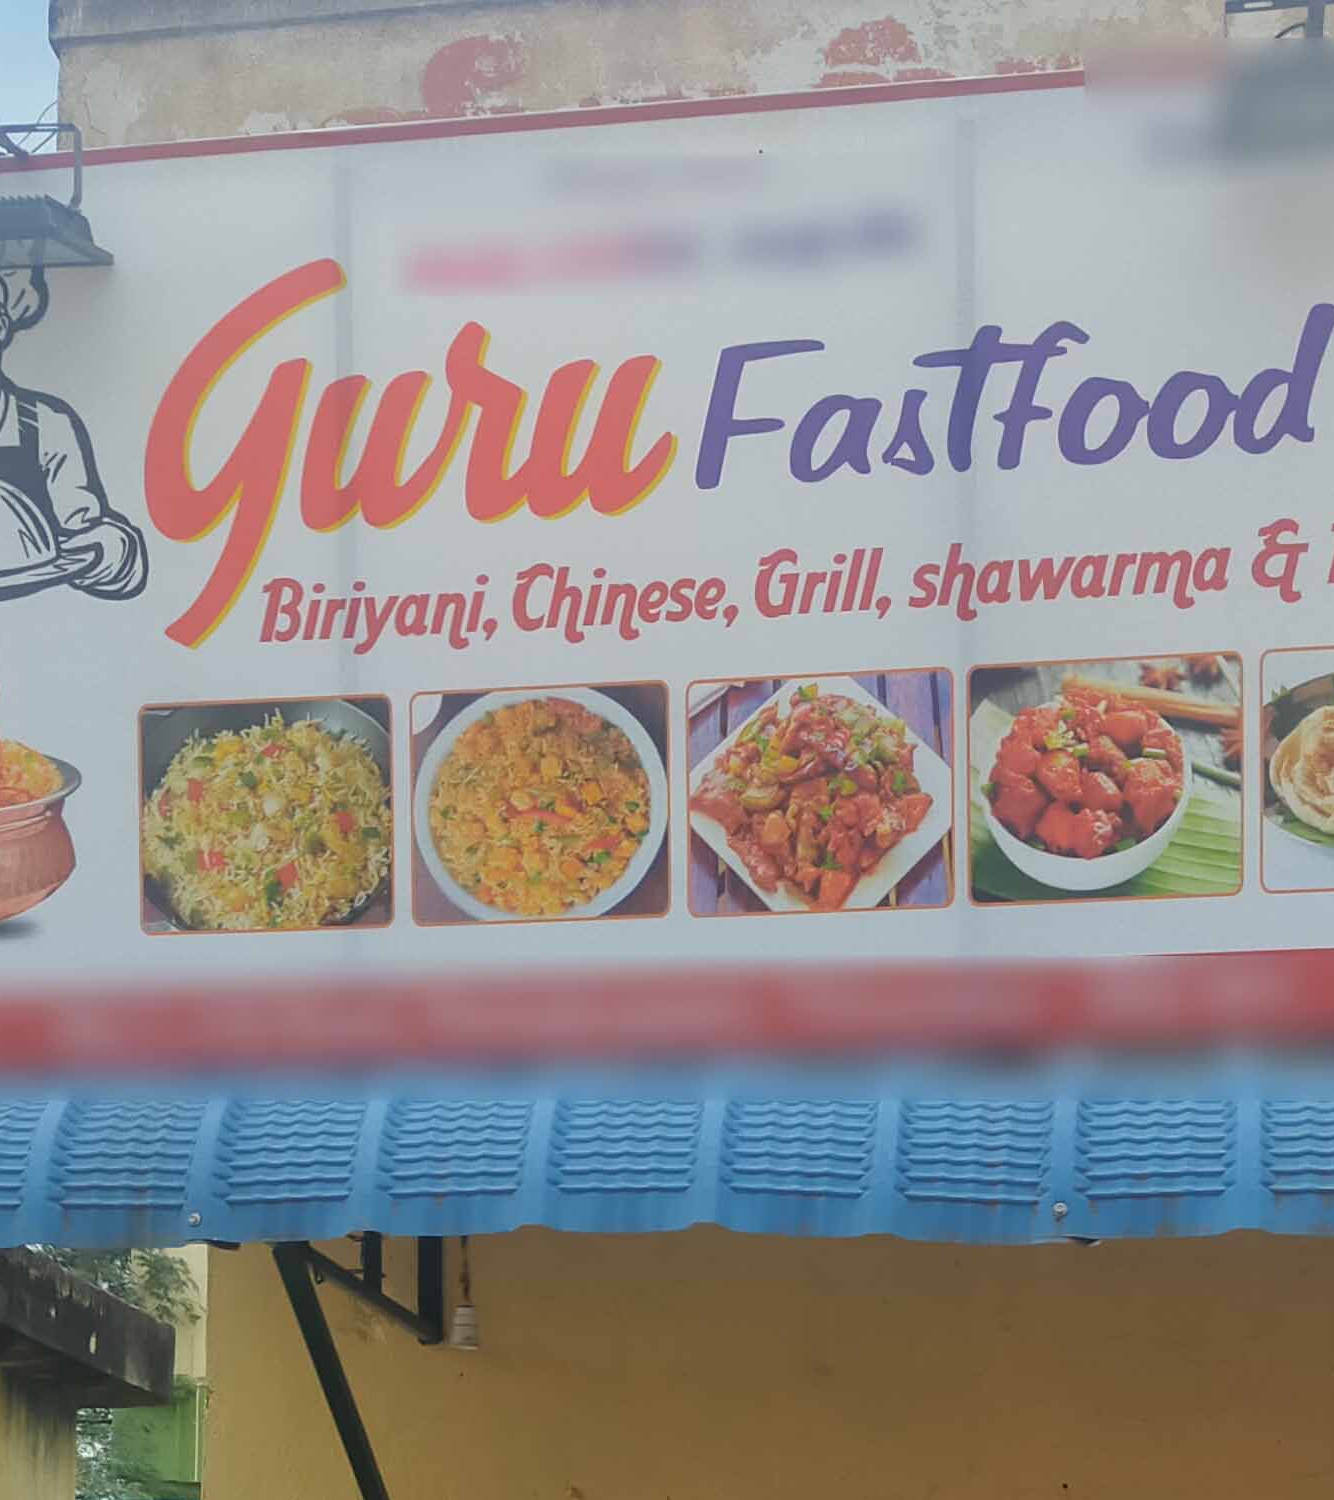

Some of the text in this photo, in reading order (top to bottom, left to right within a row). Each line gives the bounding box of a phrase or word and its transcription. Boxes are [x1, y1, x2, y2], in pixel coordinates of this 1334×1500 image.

[144, 258, 678, 650] Guru
[259, 574, 499, 655] Biriyani,
[512, 562, 739, 645] Chinese,
[755, 548, 892, 618] Grill,
[909, 543, 1232, 622] shawarma
[1253, 518, 1309, 603] &
